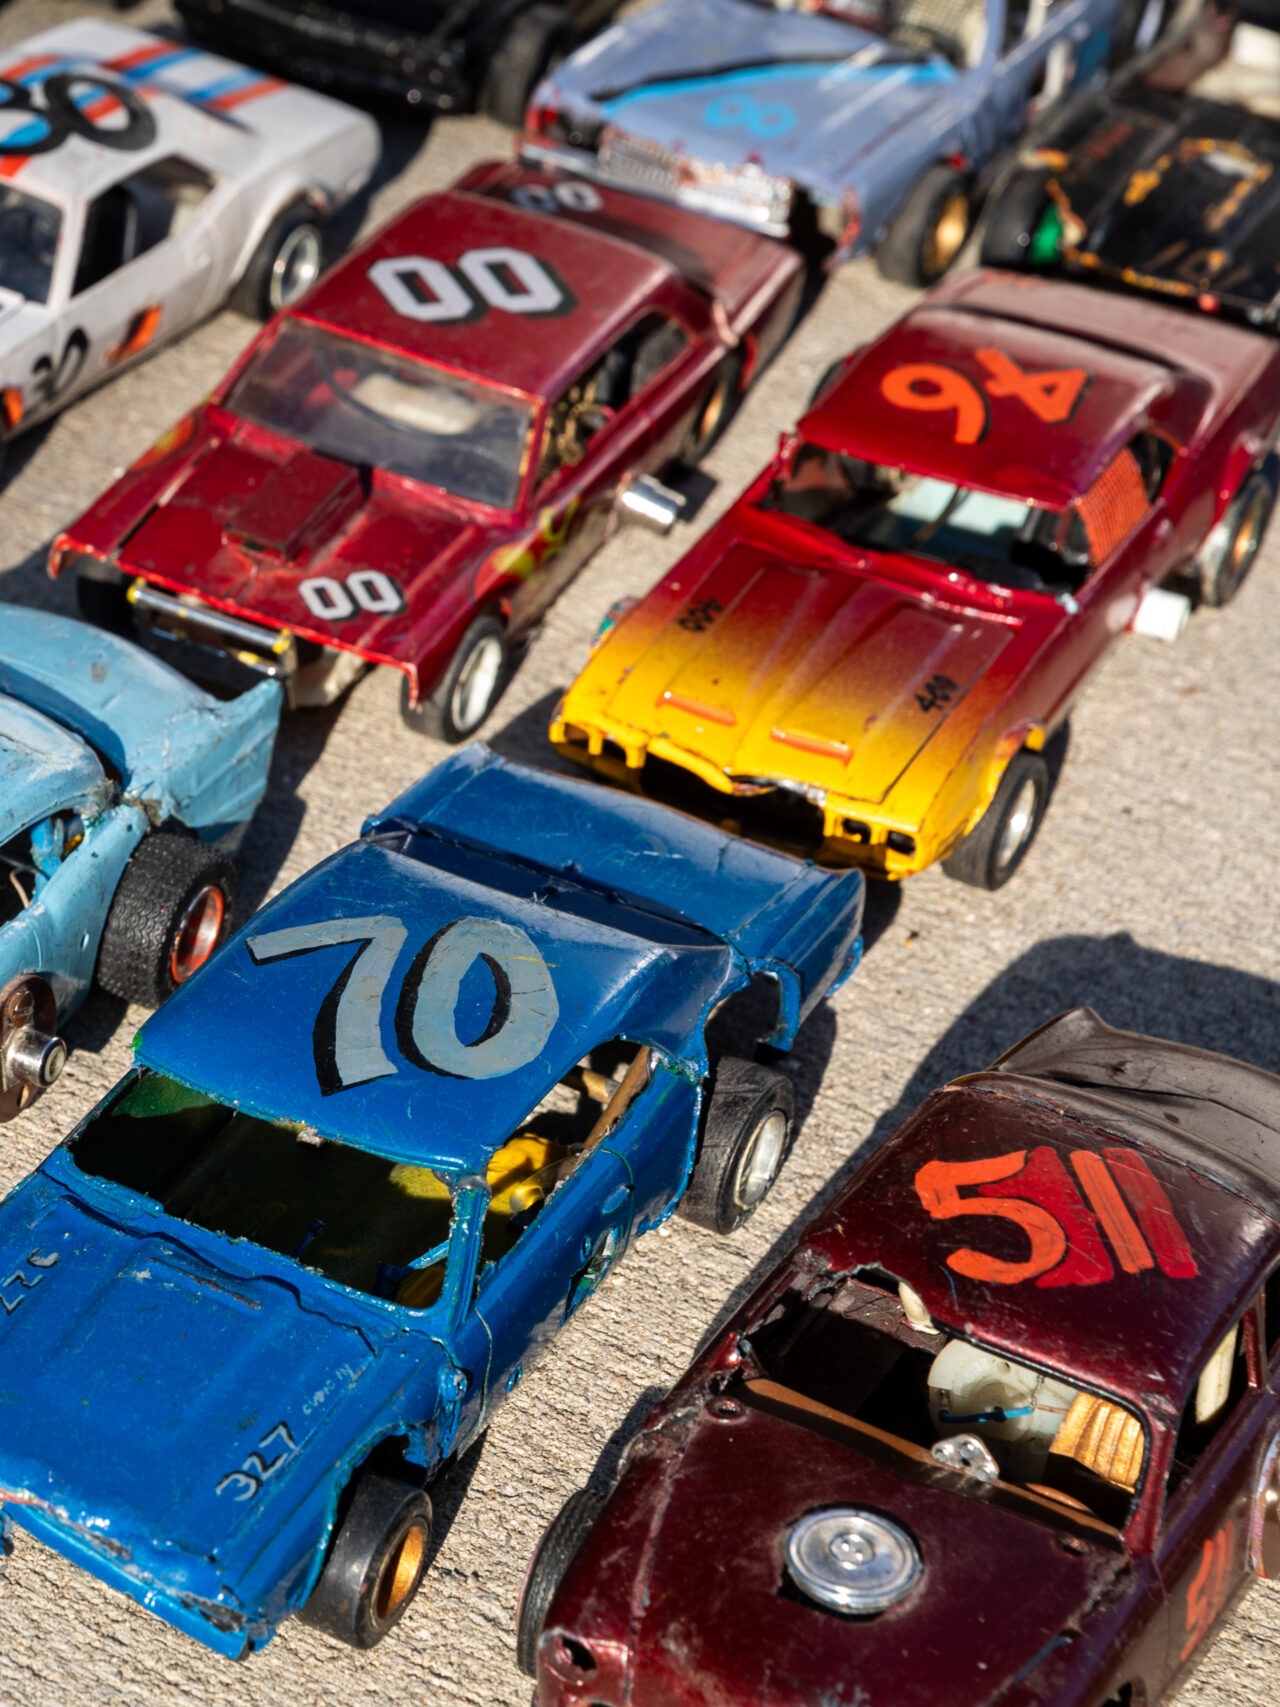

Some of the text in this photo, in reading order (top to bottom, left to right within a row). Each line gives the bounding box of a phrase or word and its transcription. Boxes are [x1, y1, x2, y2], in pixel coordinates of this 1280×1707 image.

[368, 247, 578, 324] 00
[33, 326, 90, 404] 30
[299, 570, 408, 622] 00
[247, 915, 559, 1097] 70
[215, 1420, 302, 1502] 327
